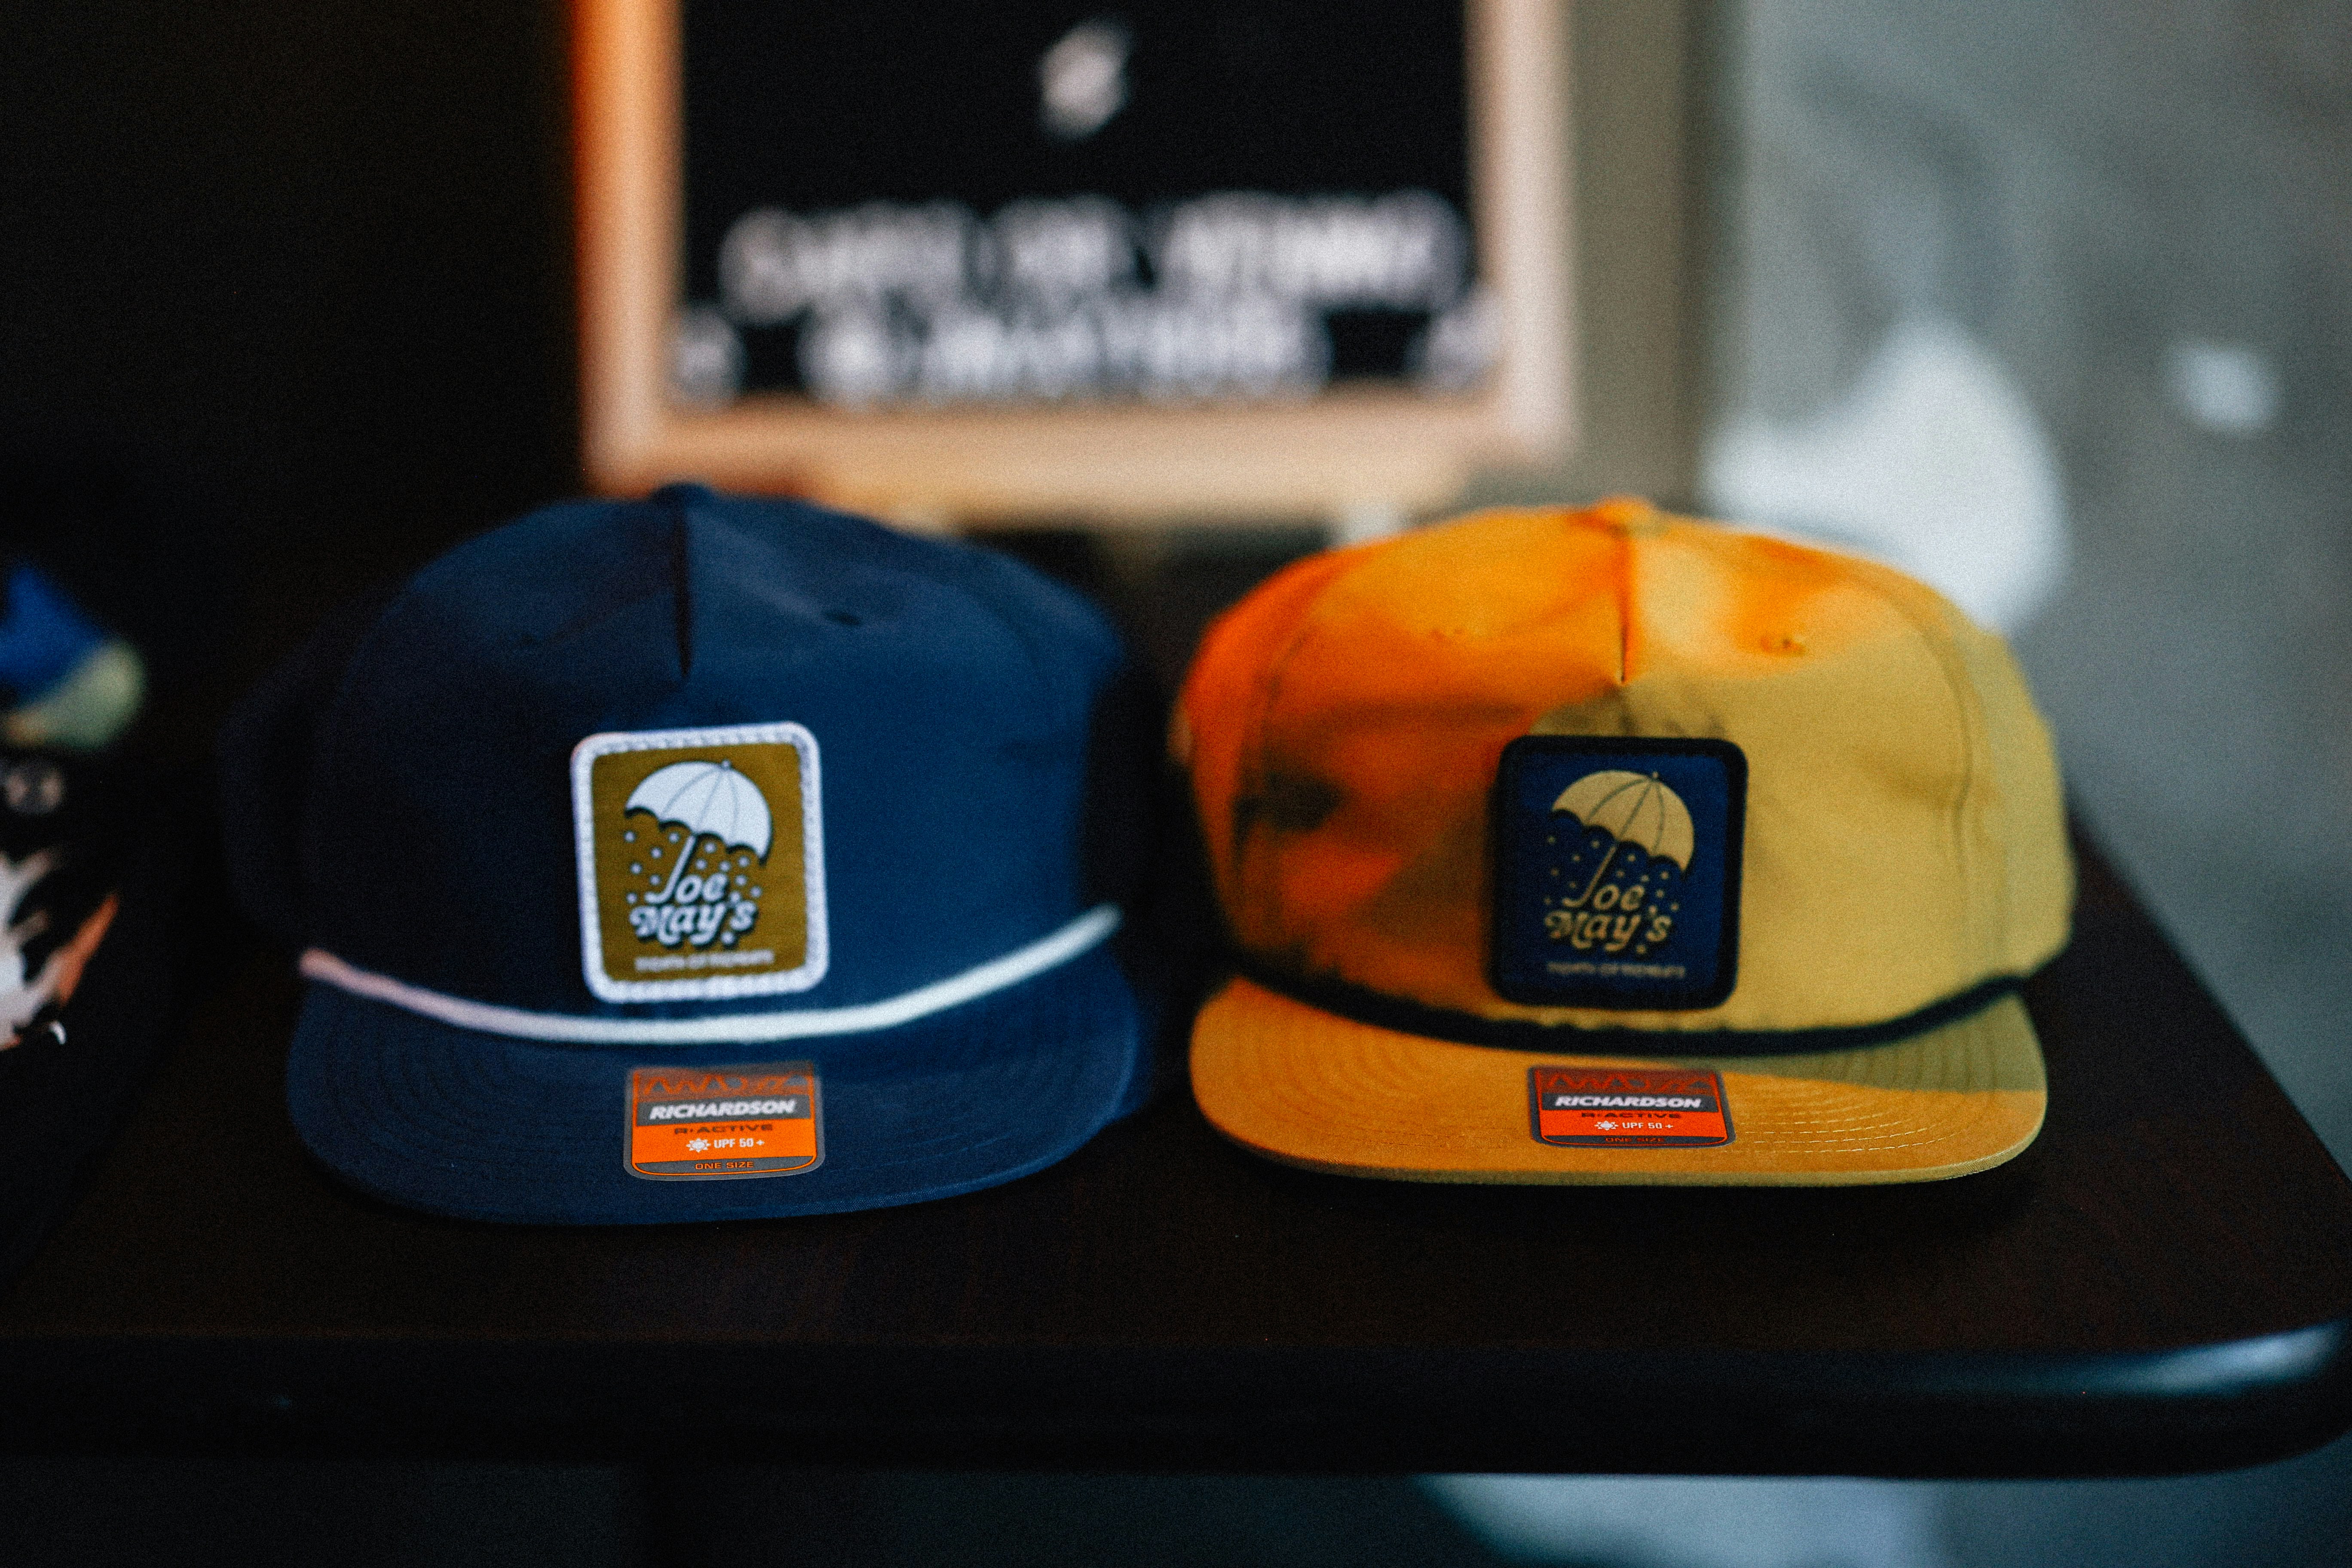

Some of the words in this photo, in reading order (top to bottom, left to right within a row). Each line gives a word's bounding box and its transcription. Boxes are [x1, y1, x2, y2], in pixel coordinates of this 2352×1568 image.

[644, 835, 729, 903] Joe
[1561, 845, 1645, 911] Joe
[649, 1099, 796, 1120] RICHARDSON
[1555, 1095, 1701, 1108] RICHARDSON
[714, 1139, 736, 1148] UPF
